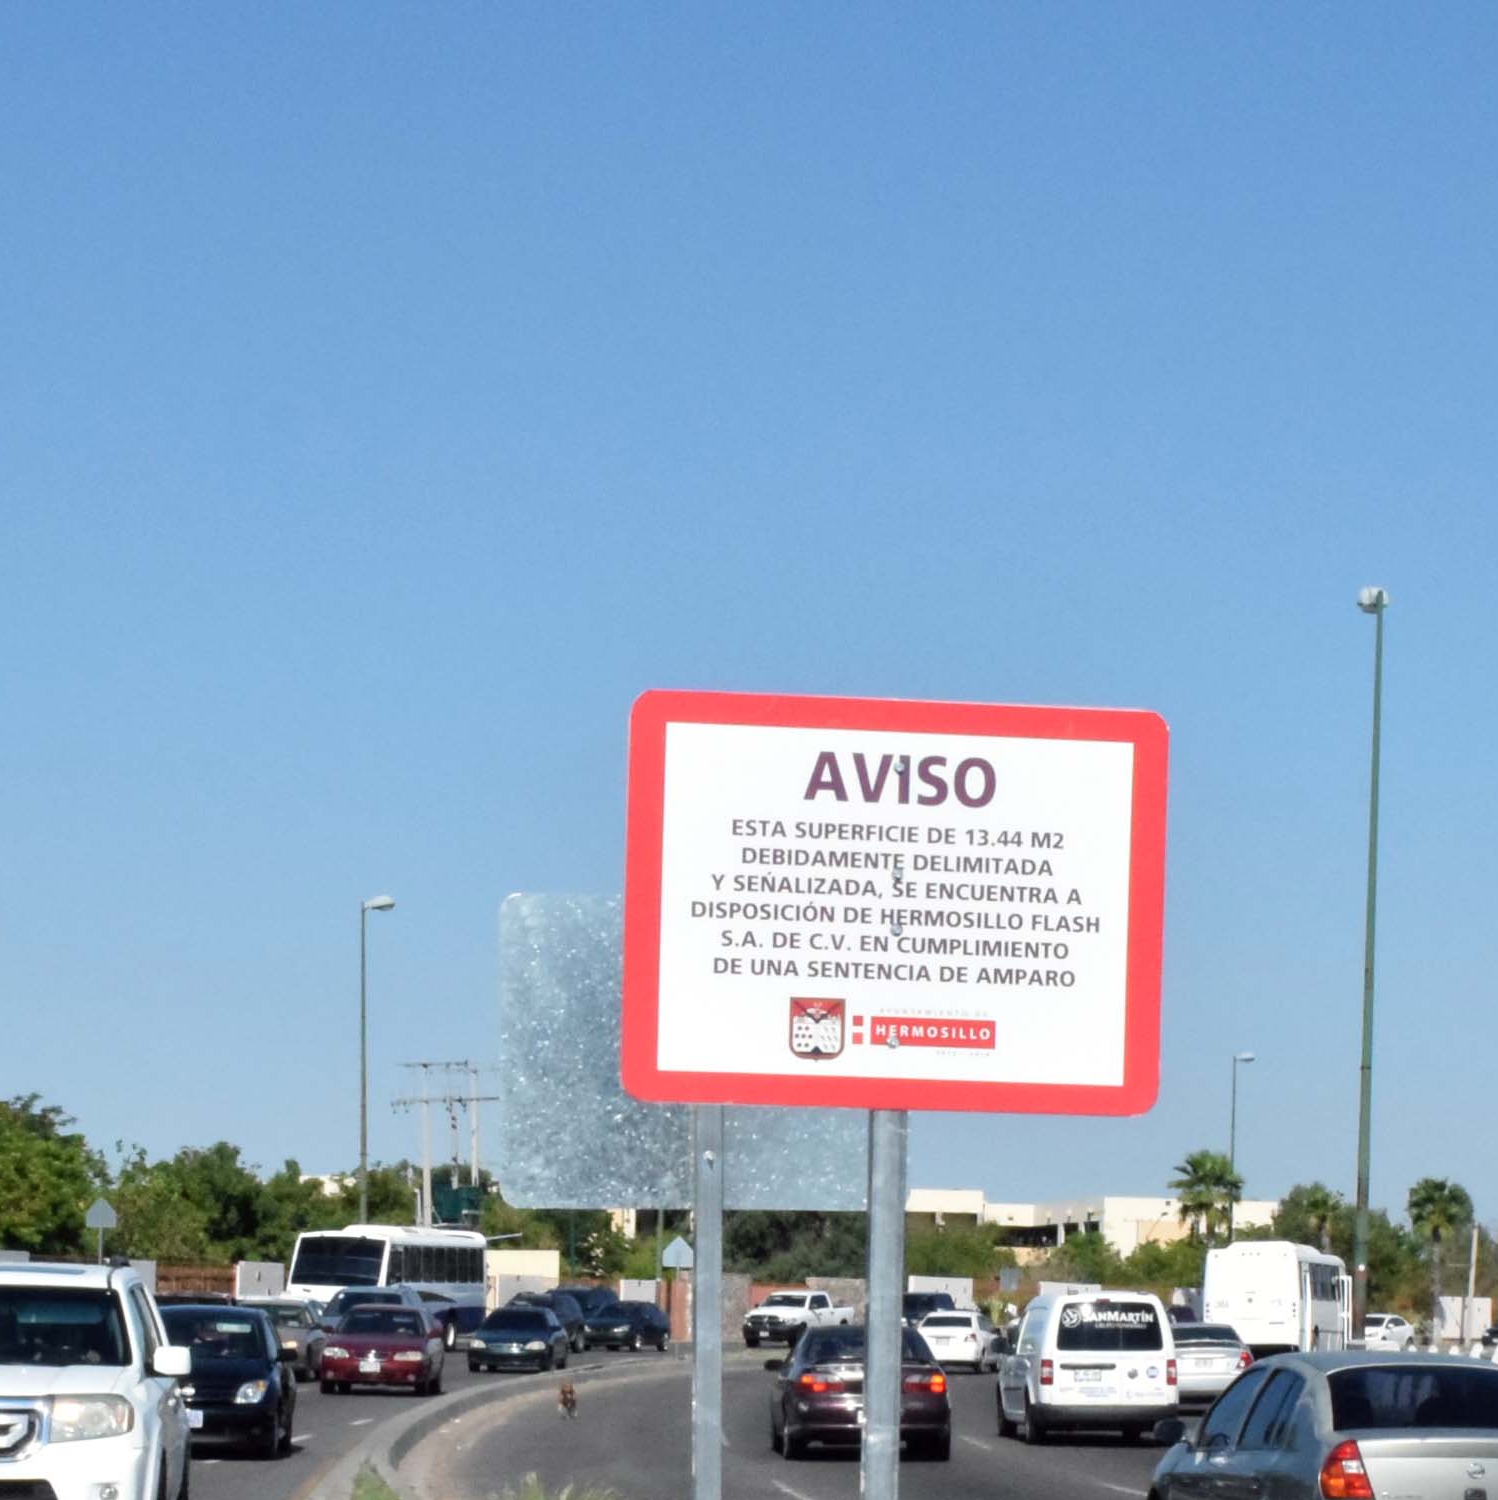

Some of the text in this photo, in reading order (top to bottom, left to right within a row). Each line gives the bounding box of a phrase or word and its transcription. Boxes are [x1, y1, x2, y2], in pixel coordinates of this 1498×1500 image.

[804, 752, 996, 808] AVISO
[733, 820, 1063, 848] ESTA SUPERFICIE DE 13.44 M2
[743, 848, 1052, 876] DEBIDAMENTE DELIMITADA
[711, 873, 725, 891] Y
[893, 881, 916, 897] SE
[926, 883, 1058, 903] ENCUENTRA
[1066, 888, 1082, 905] A
[692, 902, 1099, 932] DISPOSICIÓN DE HERMOSILLO FLASH
[721, 930, 1068, 959] S.A. DE C.V. EN CUMPLIMIENTO
[714, 958, 1074, 987] DE UNA SENTENCIA DE AMPARO
[876, 1024, 991, 1041] HERMOSILLO
